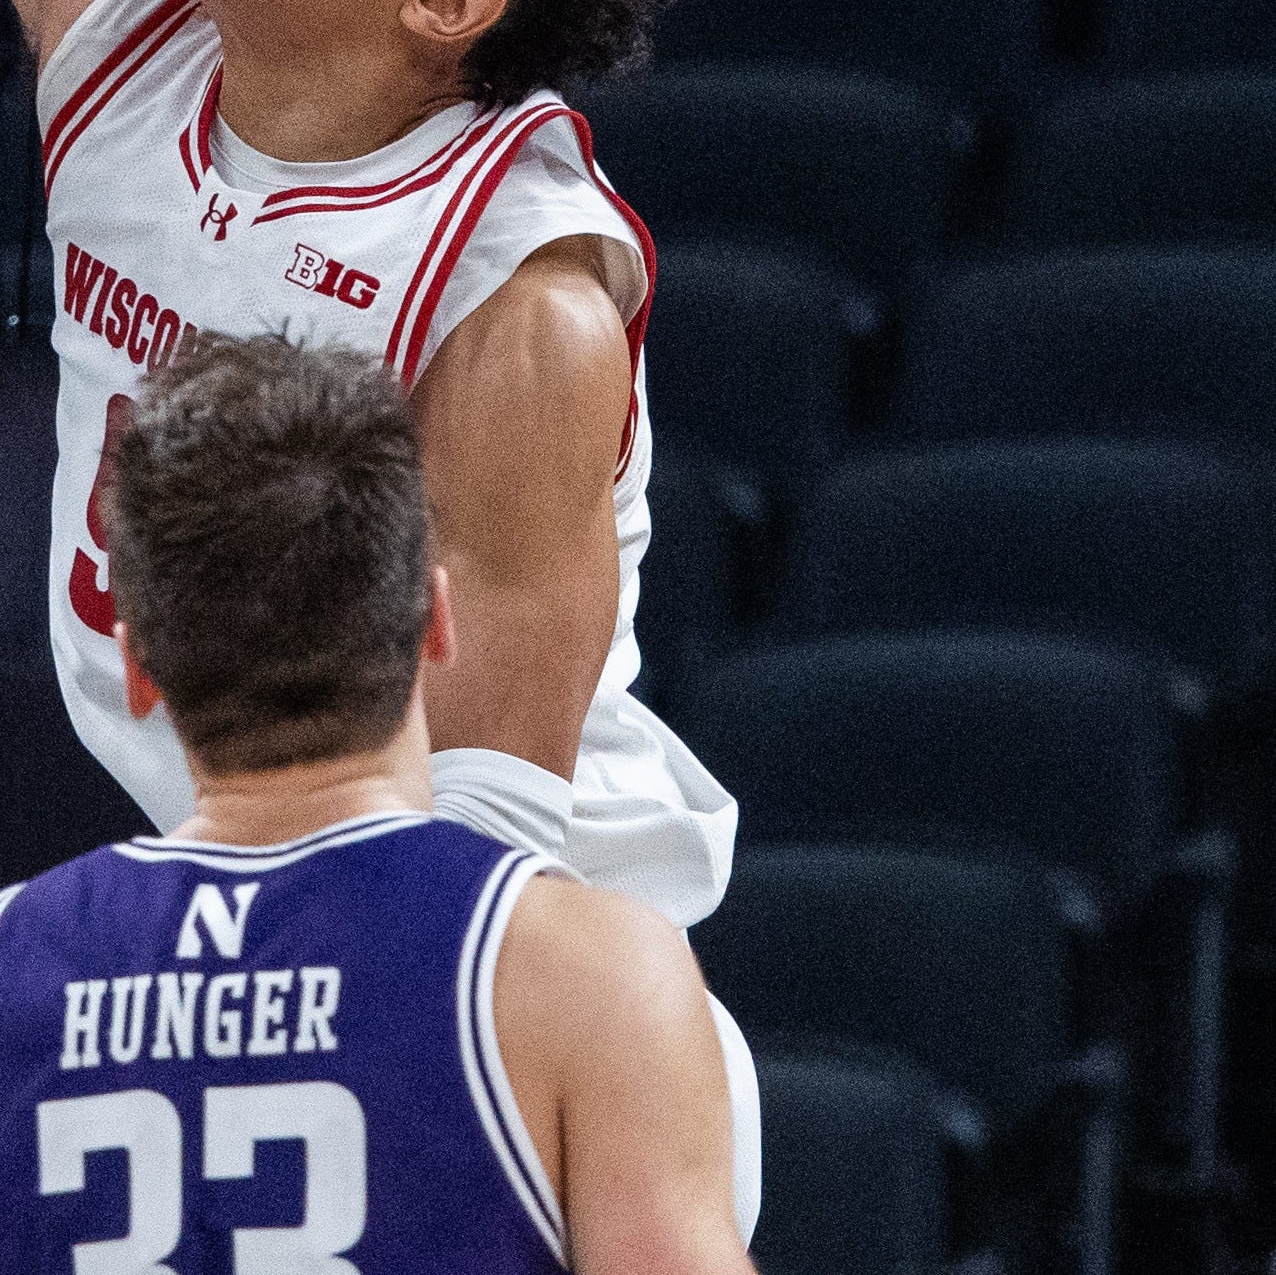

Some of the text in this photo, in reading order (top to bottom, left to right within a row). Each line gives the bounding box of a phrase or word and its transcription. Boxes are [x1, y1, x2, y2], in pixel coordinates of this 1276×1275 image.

[63, 241, 199, 372] WISCO
[175, 882, 261, 959] N
[59, 966, 343, 1071] HUNGER
